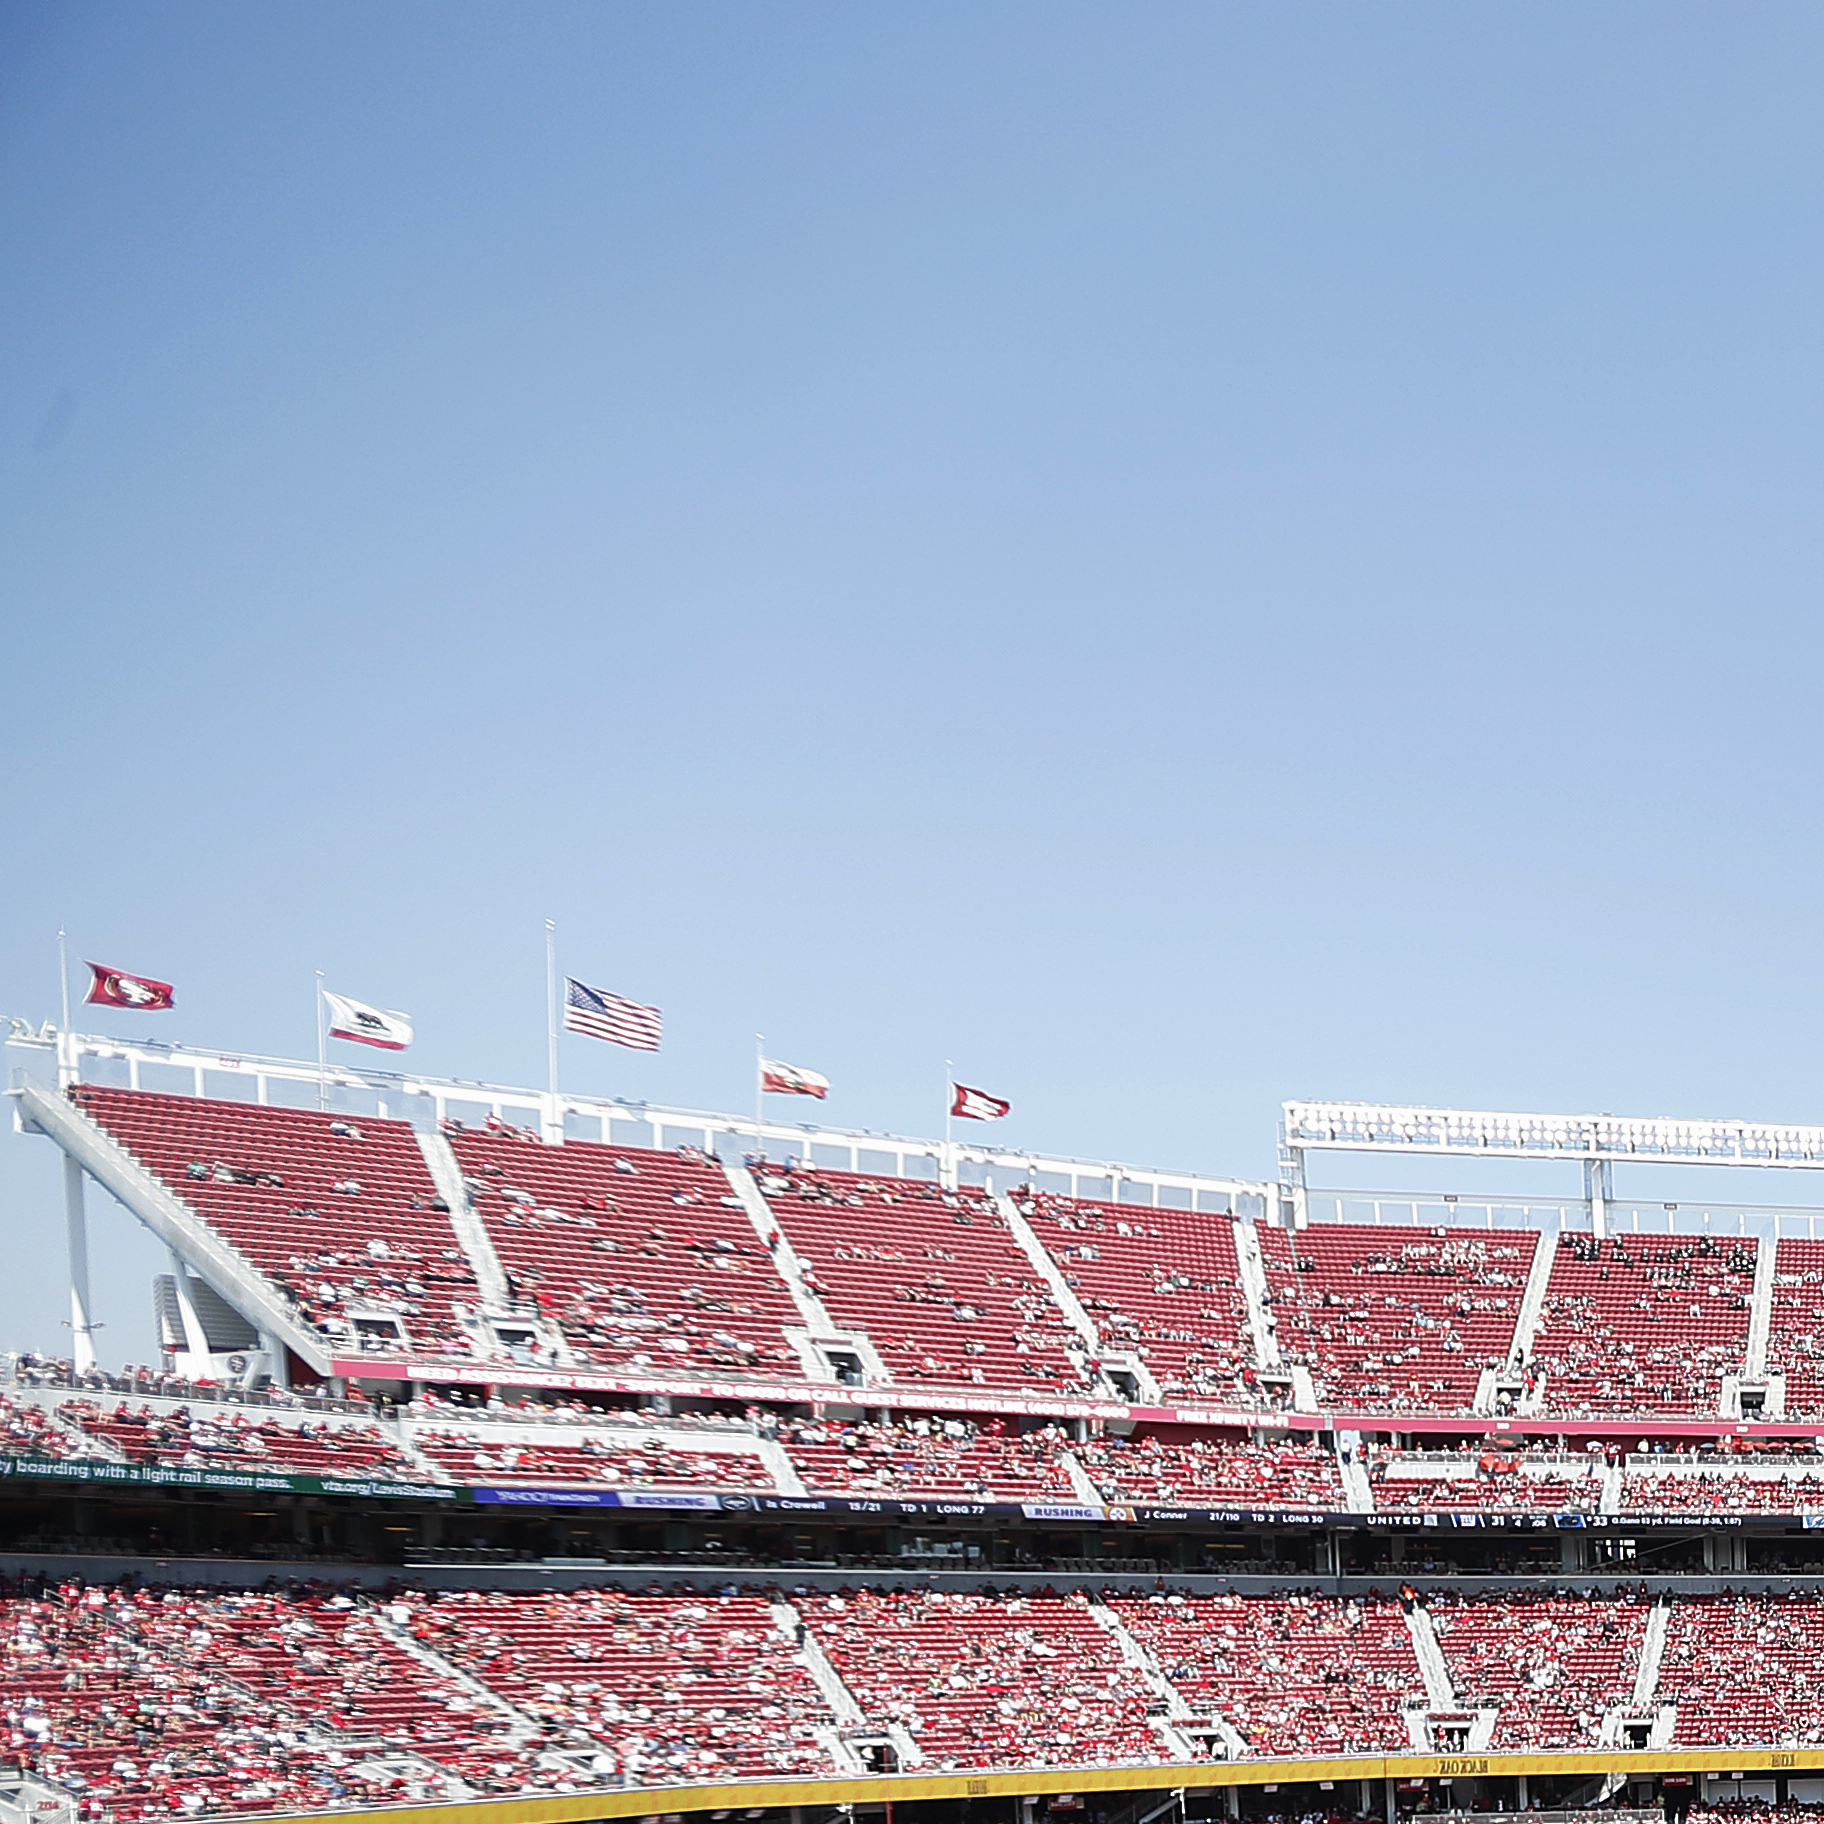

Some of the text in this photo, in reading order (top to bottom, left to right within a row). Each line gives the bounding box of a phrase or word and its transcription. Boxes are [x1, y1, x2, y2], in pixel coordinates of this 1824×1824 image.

[712, 1384, 735, 1397] TO
[788, 1387, 810, 1399] OR
[812, 1389, 848, 1400] CALL
[851, 1391, 898, 1405] GUEST
[900, 1394, 966, 1408] SERVICES
[968, 1398, 1027, 1414] HOTLINE
[1177, 1410, 1207, 1422] FREE
[1209, 1412, 1256, 1424] XFINITY
[16, 1460, 89, 1479] boarding
[93, 1465, 126, 1479] with
[129, 1470, 140, 1479] a
[142, 1467, 176, 1485] light
[178, 1471, 201, 1483] rail
[204, 1474, 253, 1486] season
[781, 1500, 826, 1511] Crowell
[849, 1501, 881, 1512] 15/21
[901, 1504, 916, 1513] TD
[937, 1505, 969, 1514] LONG
[971, 1506, 985, 1514] 77
[1034, 1507, 1092, 1518] RUSHING
[1153, 1511, 1187, 1520] Conner
[1209, 1513, 1240, 1522] 21/110
[1251, 1514, 1265, 1522] TD
[1282, 1514, 1310, 1523] LONG
[1311, 1515, 1324, 1523] 30
[1367, 1516, 1421, 1525] UNITED
[1491, 1516, 1505, 1526] 31
[1592, 1516, 1700, 1527] 33 yd. Field Goal
